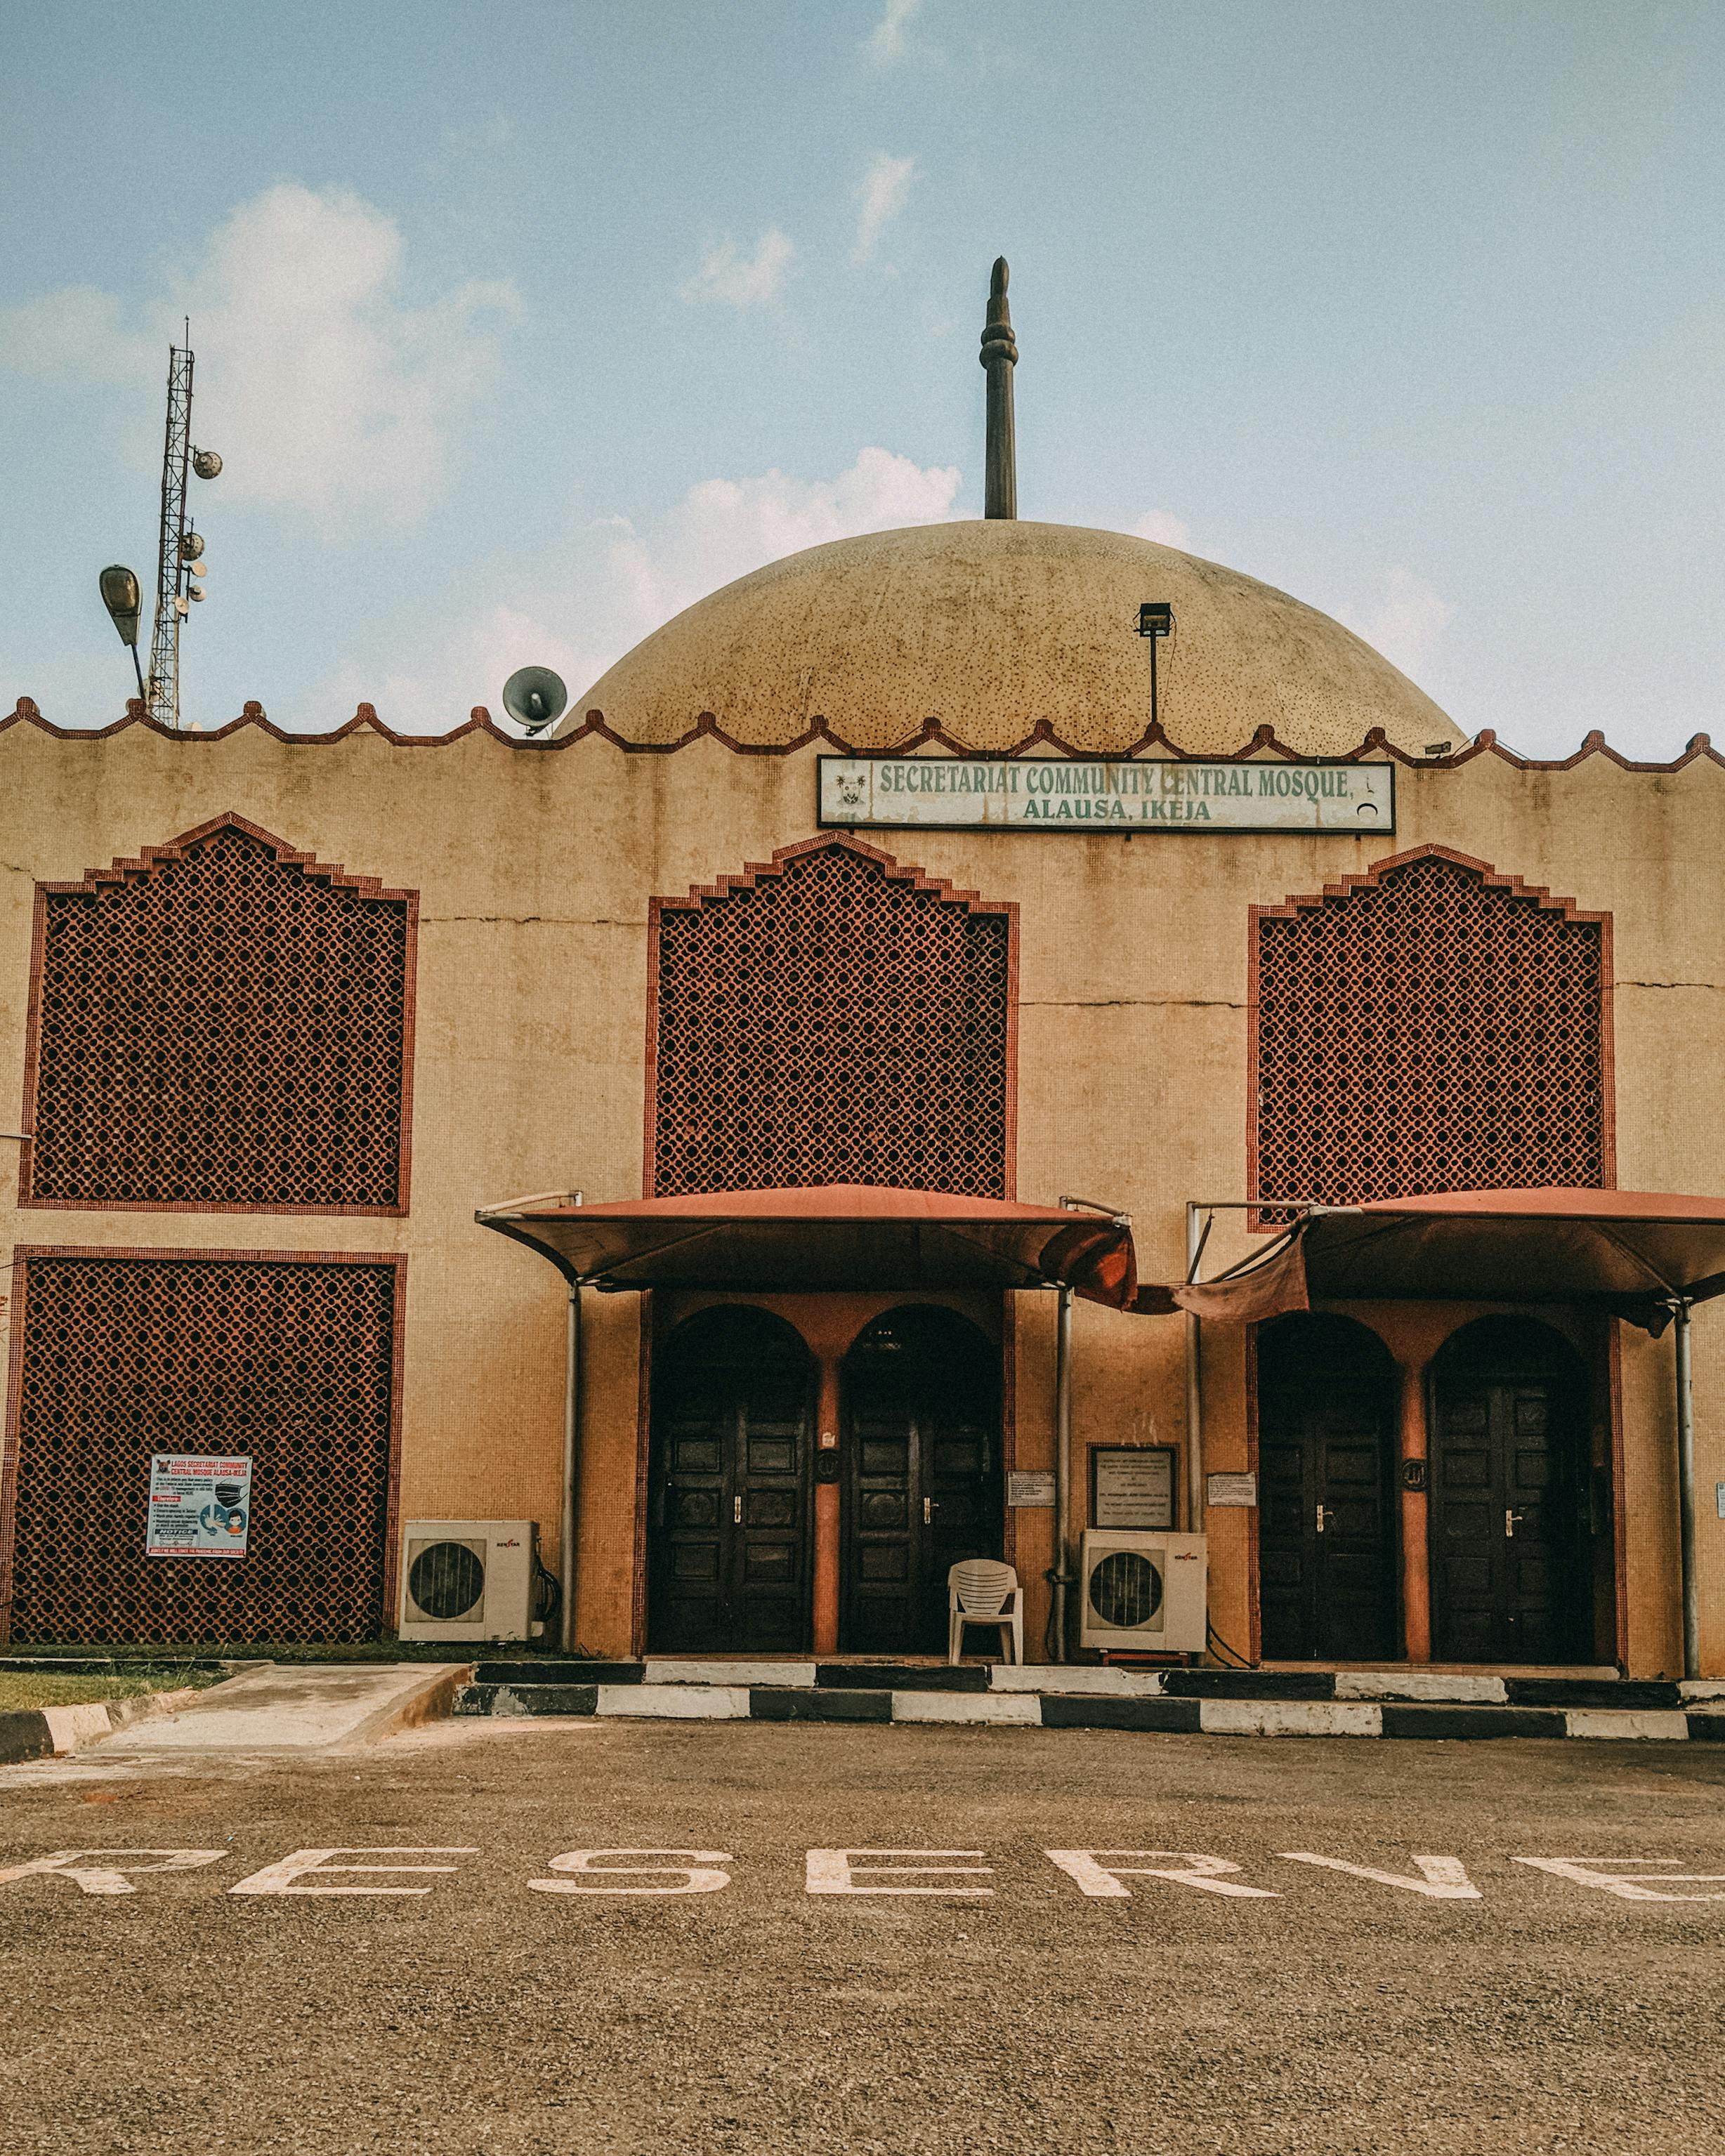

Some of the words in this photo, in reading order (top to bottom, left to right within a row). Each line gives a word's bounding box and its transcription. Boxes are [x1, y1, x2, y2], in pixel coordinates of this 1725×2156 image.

[879, 764, 1021, 794] SECRETARIAT
[1025, 766, 1154, 795] COMMUNITY
[1161, 768, 1253, 797] CENTRAL
[1259, 770, 1354, 805] MOSQUE,
[1023, 798, 1133, 821] ALAUSA,
[1141, 801, 1212, 821] IKEJA
